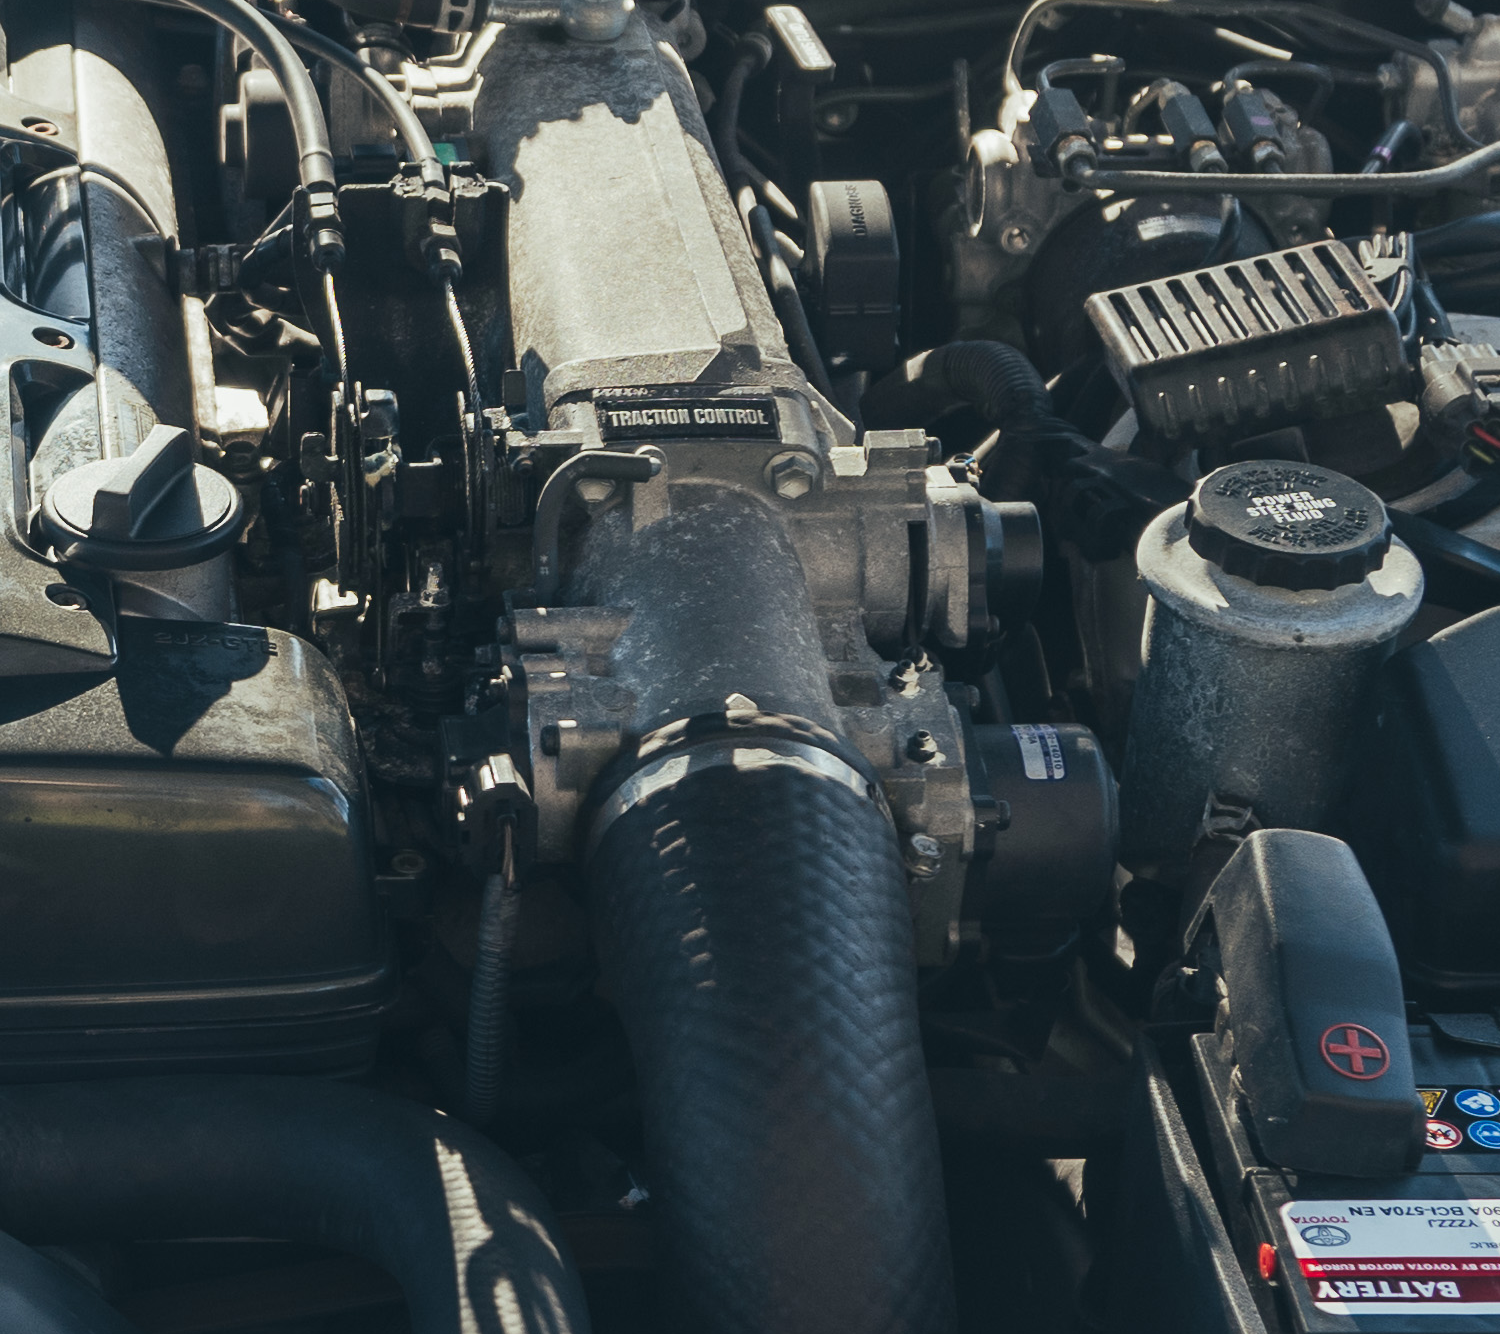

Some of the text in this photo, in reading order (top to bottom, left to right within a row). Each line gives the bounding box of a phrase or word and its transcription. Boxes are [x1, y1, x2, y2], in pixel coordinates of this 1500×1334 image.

[608, 408, 769, 427] TRACTION CONTROL
[1251, 491, 1314, 507] POWER
[1272, 509, 1325, 524] FLUID
[154, 631, 278, 657] 2JZ-GTE
[1349, 1205, 1373, 1216] EN
[1289, 1215, 1349, 1224] TOYOTA
[1308, 1262, 1355, 1271] EUROPE
[1358, 1262, 1405, 1271] MOTOR
[1408, 1262, 1457, 1271] TOYOTA
[1460, 1262, 1477, 1271] BY
[1315, 1280, 1460, 1298] BATTERY
